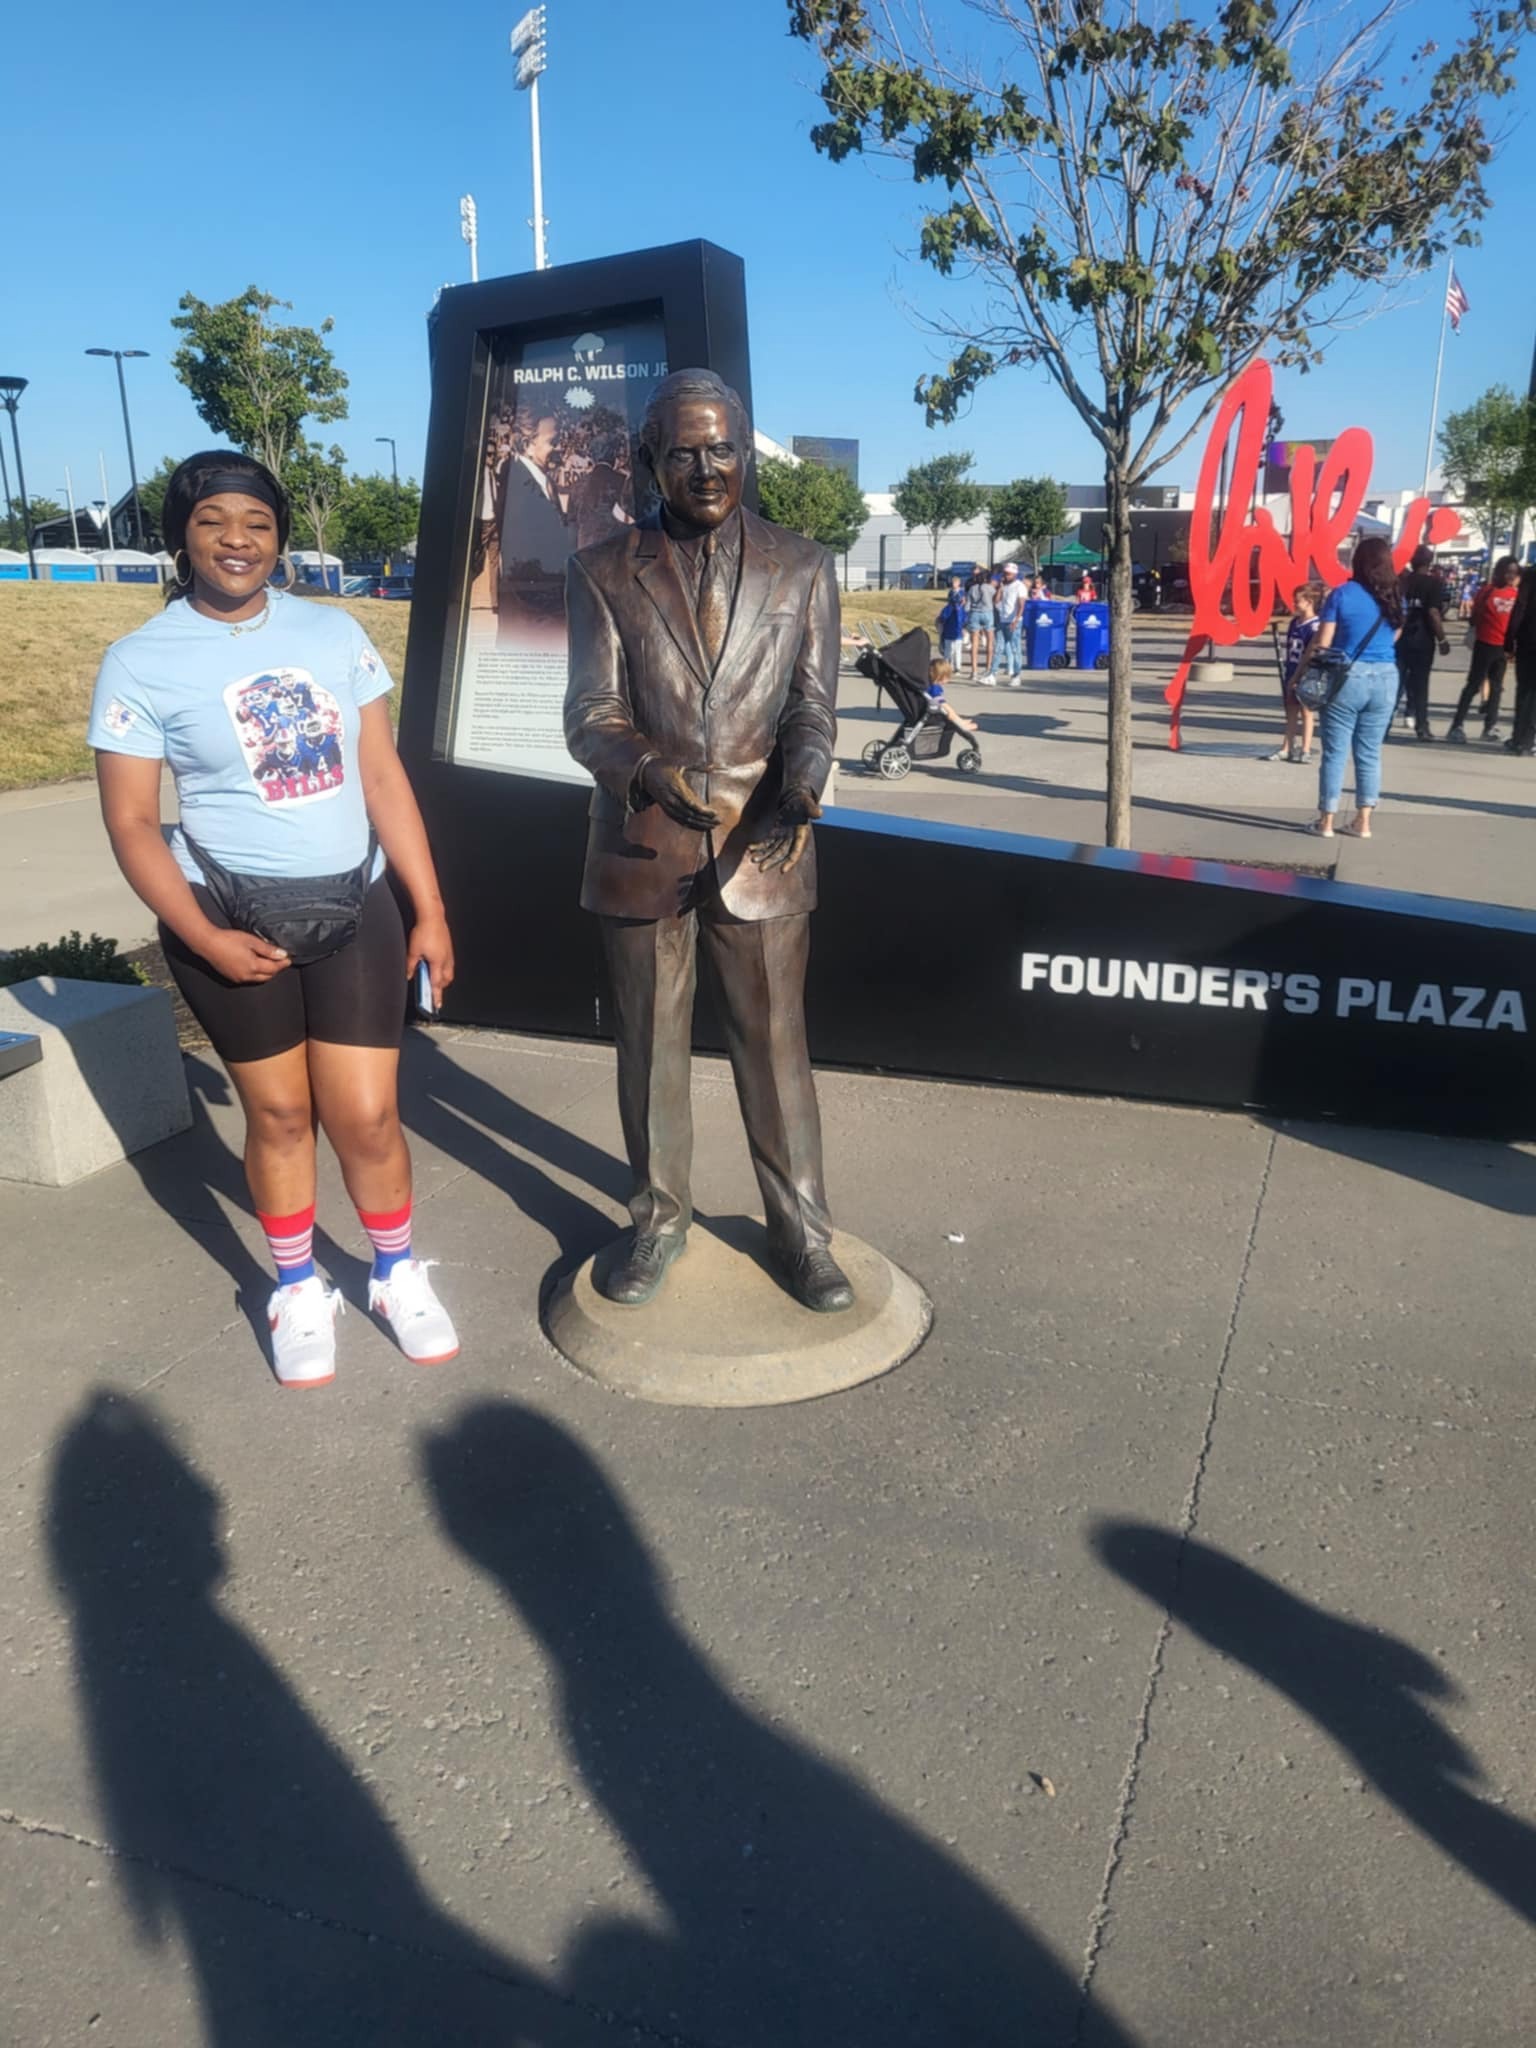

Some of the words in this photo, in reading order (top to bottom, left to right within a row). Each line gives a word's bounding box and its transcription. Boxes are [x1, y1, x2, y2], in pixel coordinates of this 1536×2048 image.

[513, 366, 564, 384] RALPH
[567, 365, 581, 382] C.
[585, 363, 648, 380] WILSON
[263, 765, 345, 802] BILLS
[1020, 951, 1321, 1016] FOUNDER'S
[1336, 976, 1528, 1033] PLAZA
